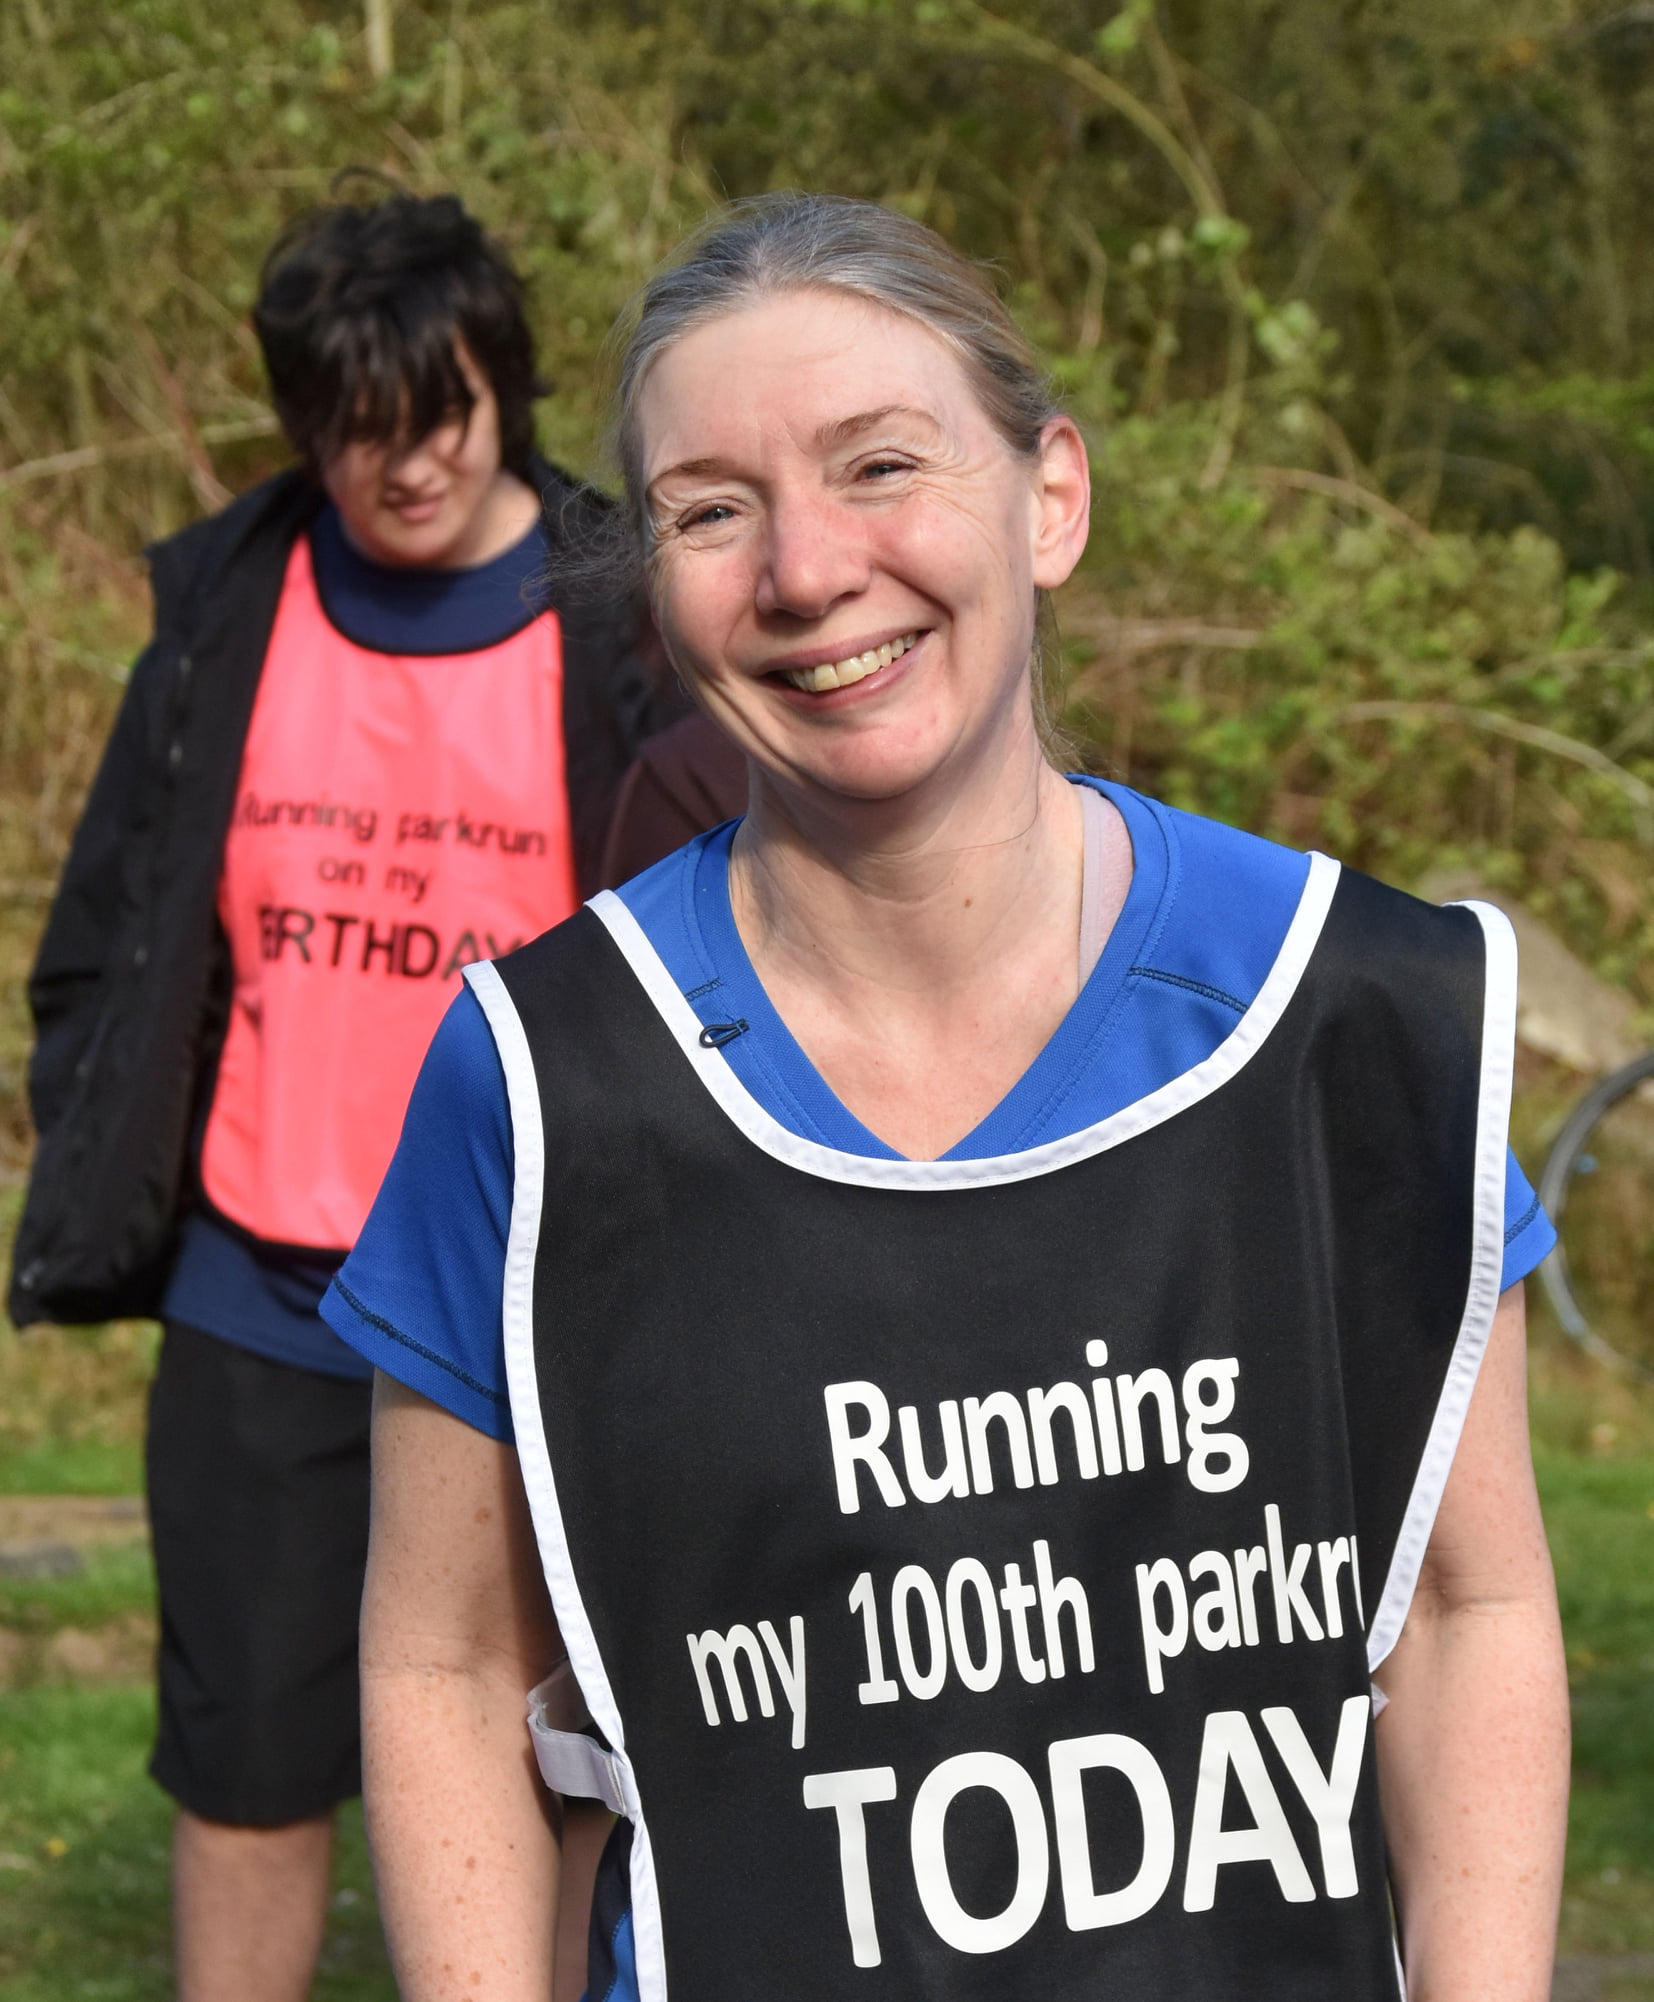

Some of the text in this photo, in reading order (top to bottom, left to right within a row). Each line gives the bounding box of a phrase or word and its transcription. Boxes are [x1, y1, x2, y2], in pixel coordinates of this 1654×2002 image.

[317, 856, 365, 887] on
[822, 1339, 1251, 1515] Running
[686, 1503, 1366, 1750] my 100th parkr
[802, 1694, 1371, 1969] TODAY
